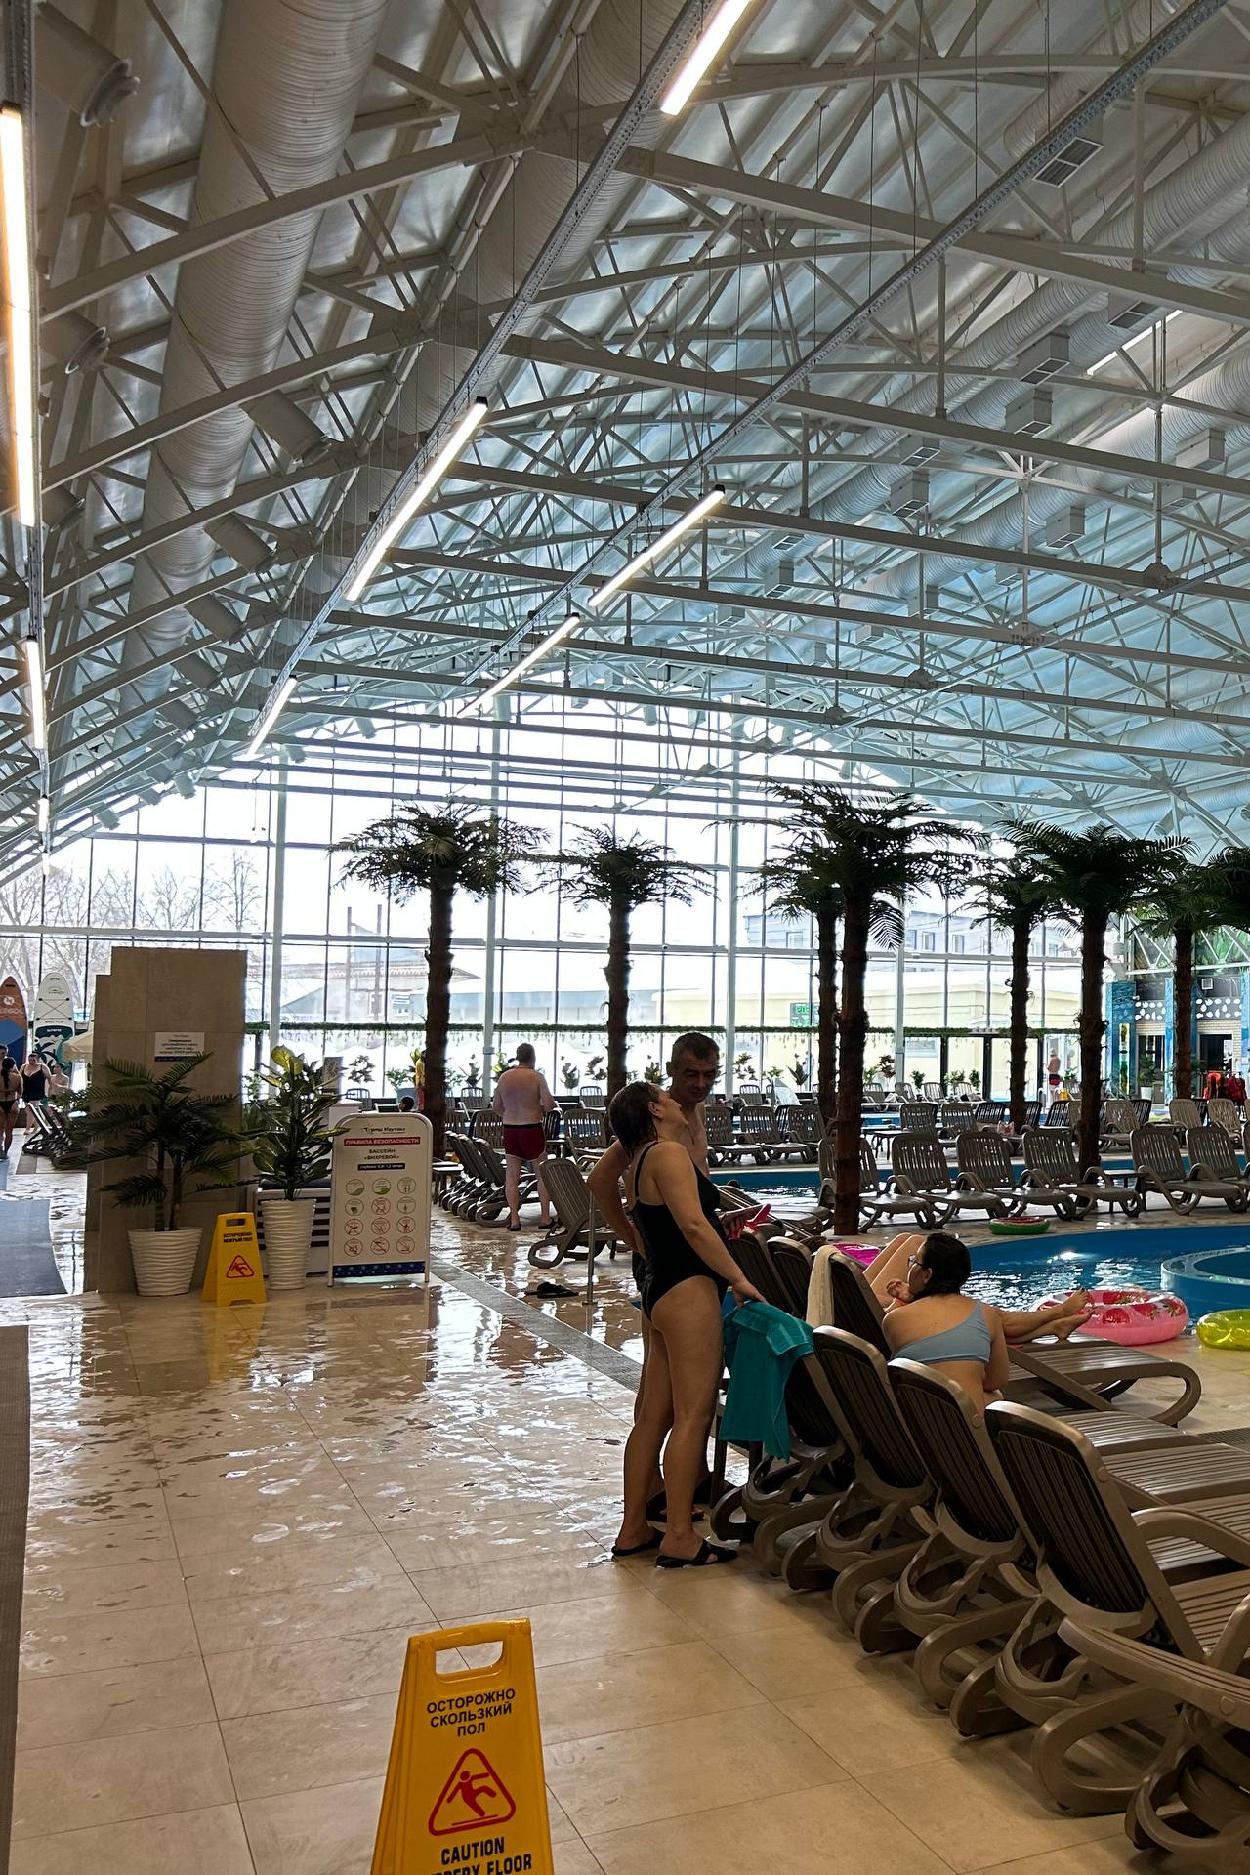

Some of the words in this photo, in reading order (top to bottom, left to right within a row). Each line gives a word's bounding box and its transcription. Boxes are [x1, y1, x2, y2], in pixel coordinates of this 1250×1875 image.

[427, 1688, 516, 1714] ОСТОРОЖНО
[430, 1701, 512, 1728] СКОЛЬЗКИЙ
[457, 1722, 485, 1737] ПОЛ
[440, 1837, 505, 1865] CAUTION
[486, 1853, 532, 1875] FLOOR
